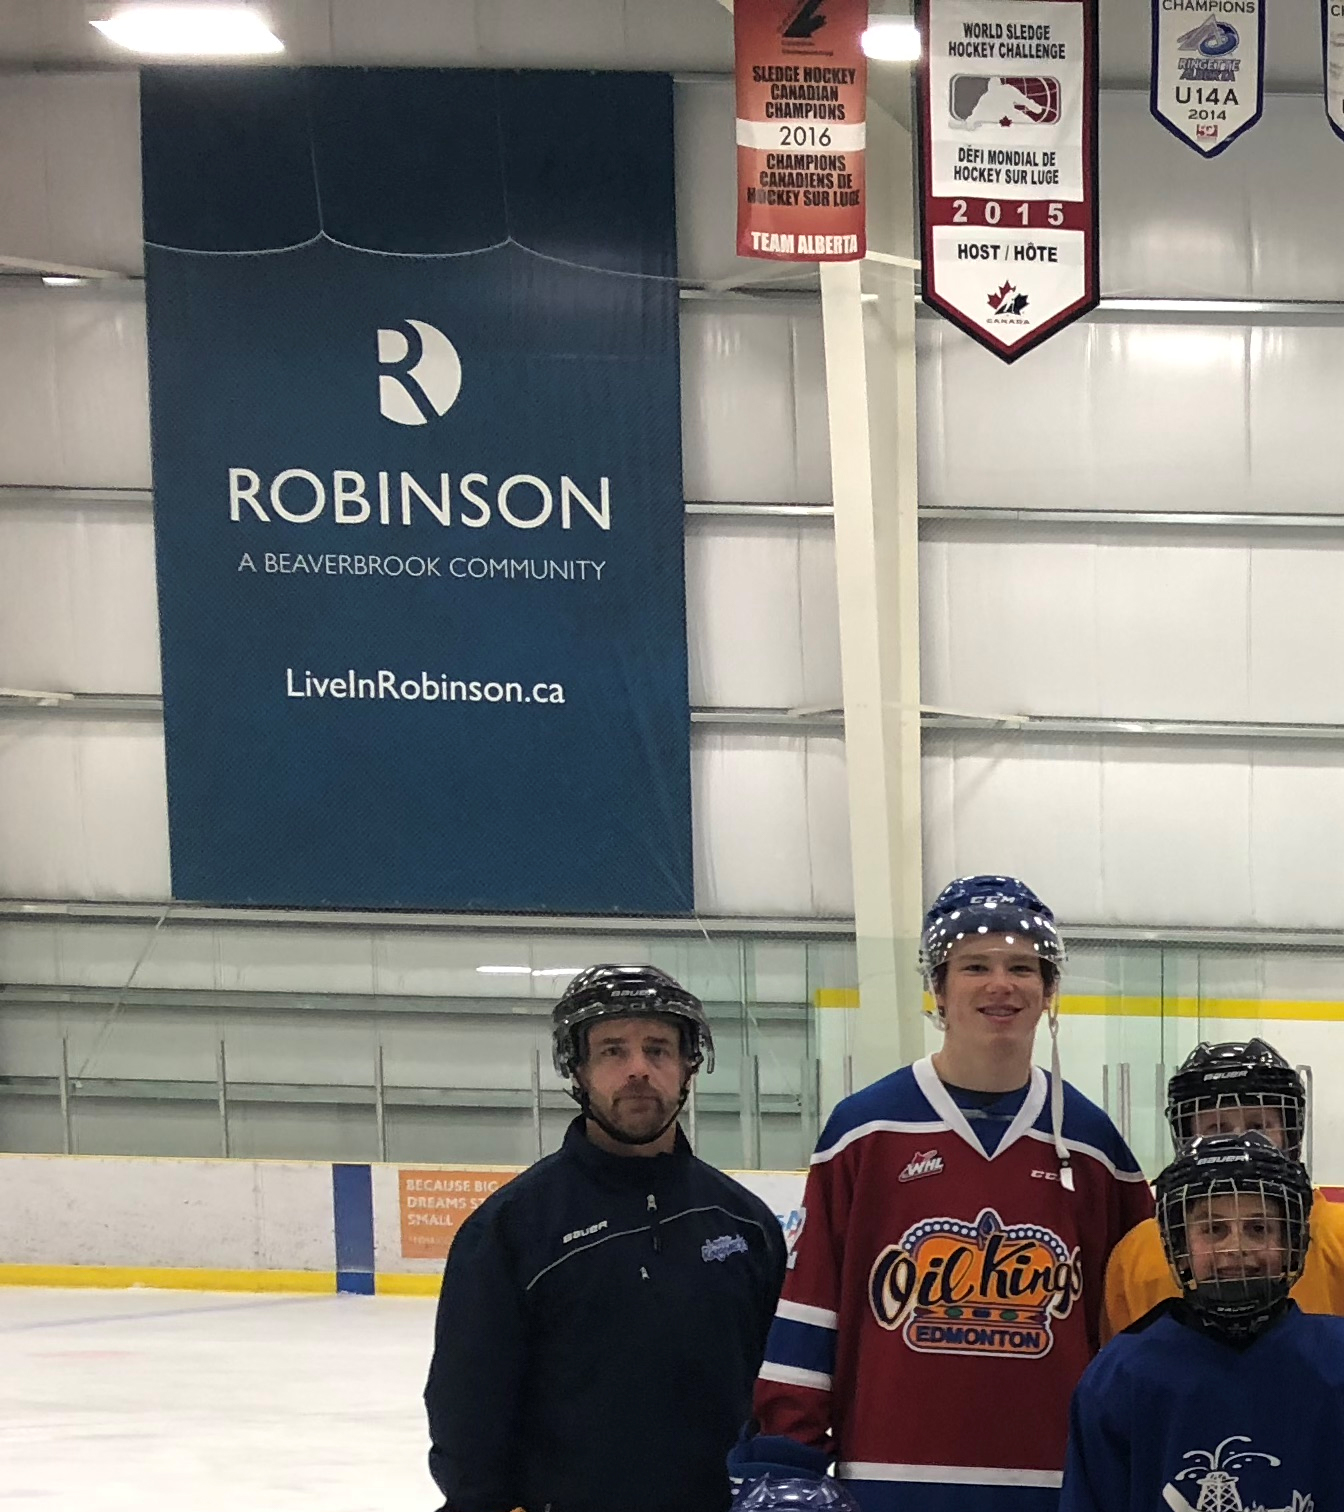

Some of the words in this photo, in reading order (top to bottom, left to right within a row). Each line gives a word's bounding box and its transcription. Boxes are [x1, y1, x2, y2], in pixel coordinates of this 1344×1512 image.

[1162, 0, 1255, 14] CHAMPIONS
[963, 22, 1003, 40] WORLD
[1006, 23, 1051, 41] SLEDGE
[949, 40, 995, 58] HOCKEY
[999, 42, 1066, 60] CHALLENGE
[1178, 58, 1241, 71] RINGETTE
[752, 66, 800, 84] SLEDGE
[803, 67, 856, 85] HOCKEY
[770, 85, 839, 103] CANADIAN
[765, 102, 846, 120] CHAMPIONS
[1188, 109, 1227, 121] 2014
[779, 126, 832, 147] 2016
[766, 153, 846, 172] CHAMPIONS
[958, 142, 984, 164] DÉFI
[986, 149, 1040, 167] MONDIAL
[1042, 150, 1057, 167] DE
[759, 171, 834, 190] CANADIENS
[836, 173, 853, 190] DE
[953, 165, 1002, 184] HOCKEY
[1004, 166, 1030, 184] SUR
[1032, 168, 1060, 186] LUGE
[747, 189, 801, 207] HOCKEY
[803, 189, 831, 207] SUR
[751, 231, 795, 254] TEAM
[797, 233, 858, 255] ALBERTA
[957, 243, 1001, 261] HOST
[1013, 242, 1059, 263] HÔTE
[228, 467, 612, 531] ROBINSON
[238, 553, 256, 572] A
[264, 553, 442, 578] BEAVERBROOK
[449, 557, 607, 581] COMMUNITY
[286, 667, 565, 705] LiveInRobinson.ca
[970, 894, 1016, 905] CCM
[610, 988, 657, 998] BAUER
[1203, 1069, 1248, 1081] BAUER
[906, 1157, 945, 1176] WHL
[1197, 1153, 1249, 1166] BAUER
[1030, 1169, 1061, 1181] CC
[406, 1178, 471, 1194] BECAUSE
[406, 1195, 467, 1210] DREAMS
[407, 1212, 454, 1227] SMALL
[562, 1220, 609, 1245] BAUER
[872, 1244, 975, 1328] Oil
[979, 1232, 1084, 1320] Kings
[915, 1325, 1042, 1349] EDMONTON
